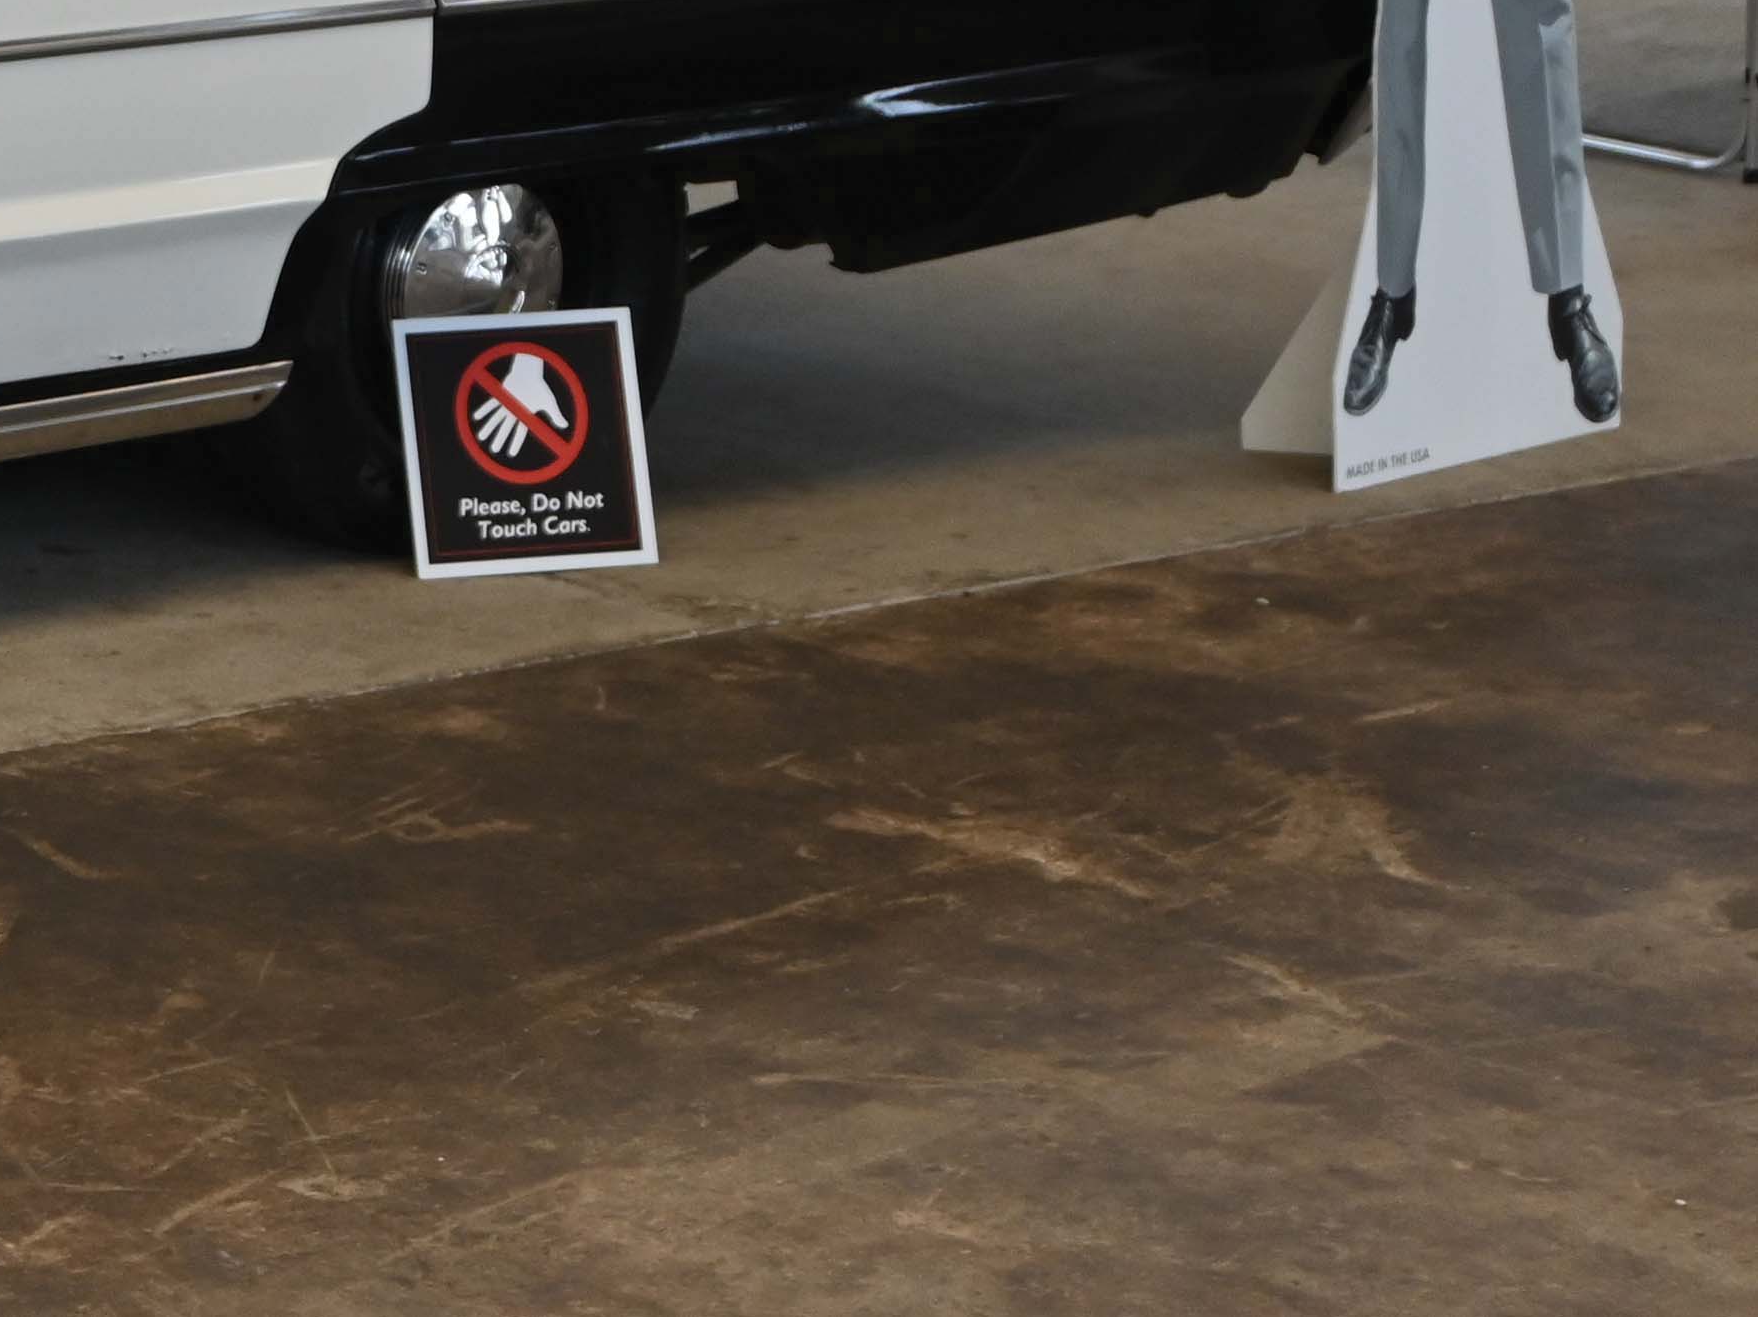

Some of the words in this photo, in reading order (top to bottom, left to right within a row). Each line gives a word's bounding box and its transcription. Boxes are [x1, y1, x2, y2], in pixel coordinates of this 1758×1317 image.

[1346, 458, 1374, 479] MADE
[1378, 455, 1388, 471] IN
[1391, 451, 1407, 467] THE
[1411, 447, 1430, 463] USA
[458, 497, 526, 518] Please,
[532, 493, 561, 513] Do
[566, 491, 604, 510] Not
[478, 516, 537, 539] Touch
[543, 516, 591, 536] Cars.
